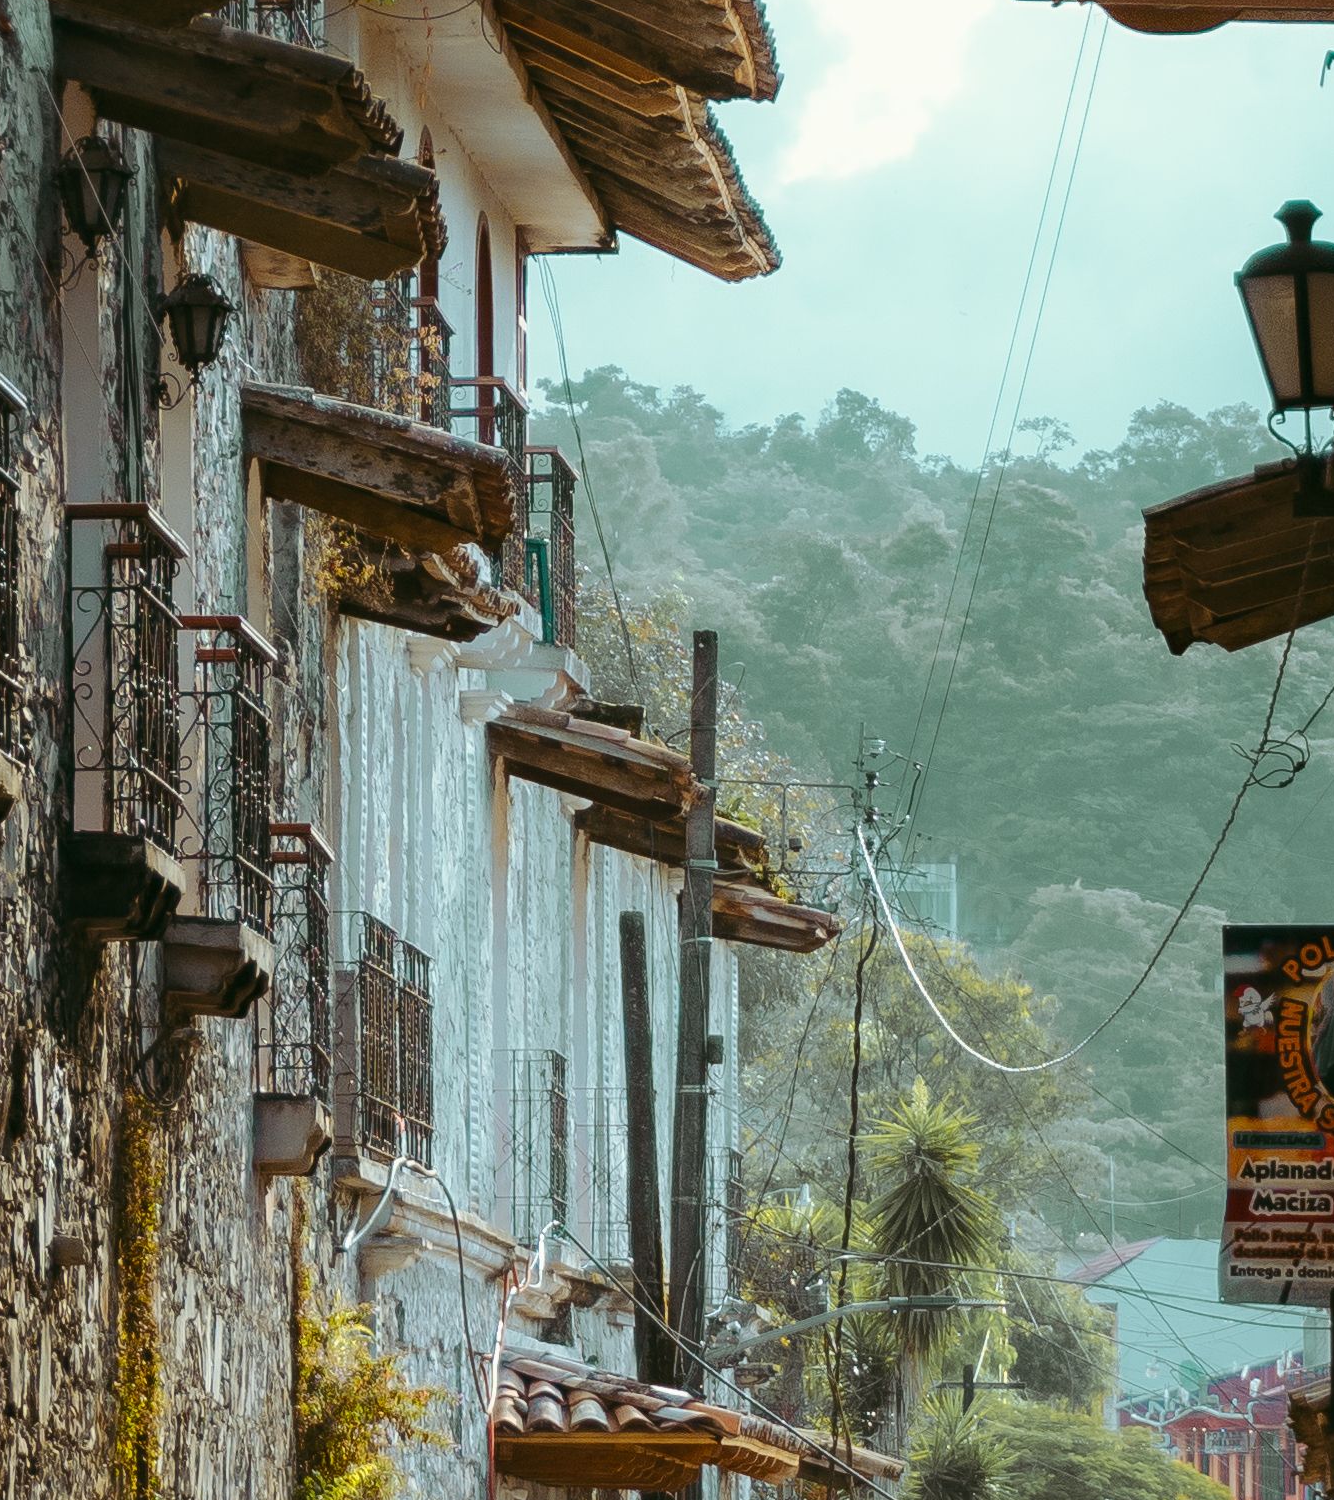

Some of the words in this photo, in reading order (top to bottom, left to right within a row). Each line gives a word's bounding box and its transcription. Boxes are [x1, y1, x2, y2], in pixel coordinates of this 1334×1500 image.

[1277, 998, 1319, 1116] NUESTRA
[1252, 1191, 1331, 1212] Maciza
[1230, 1265, 1281, 1279] Entrega
[1285, 1268, 1294, 1278] a
